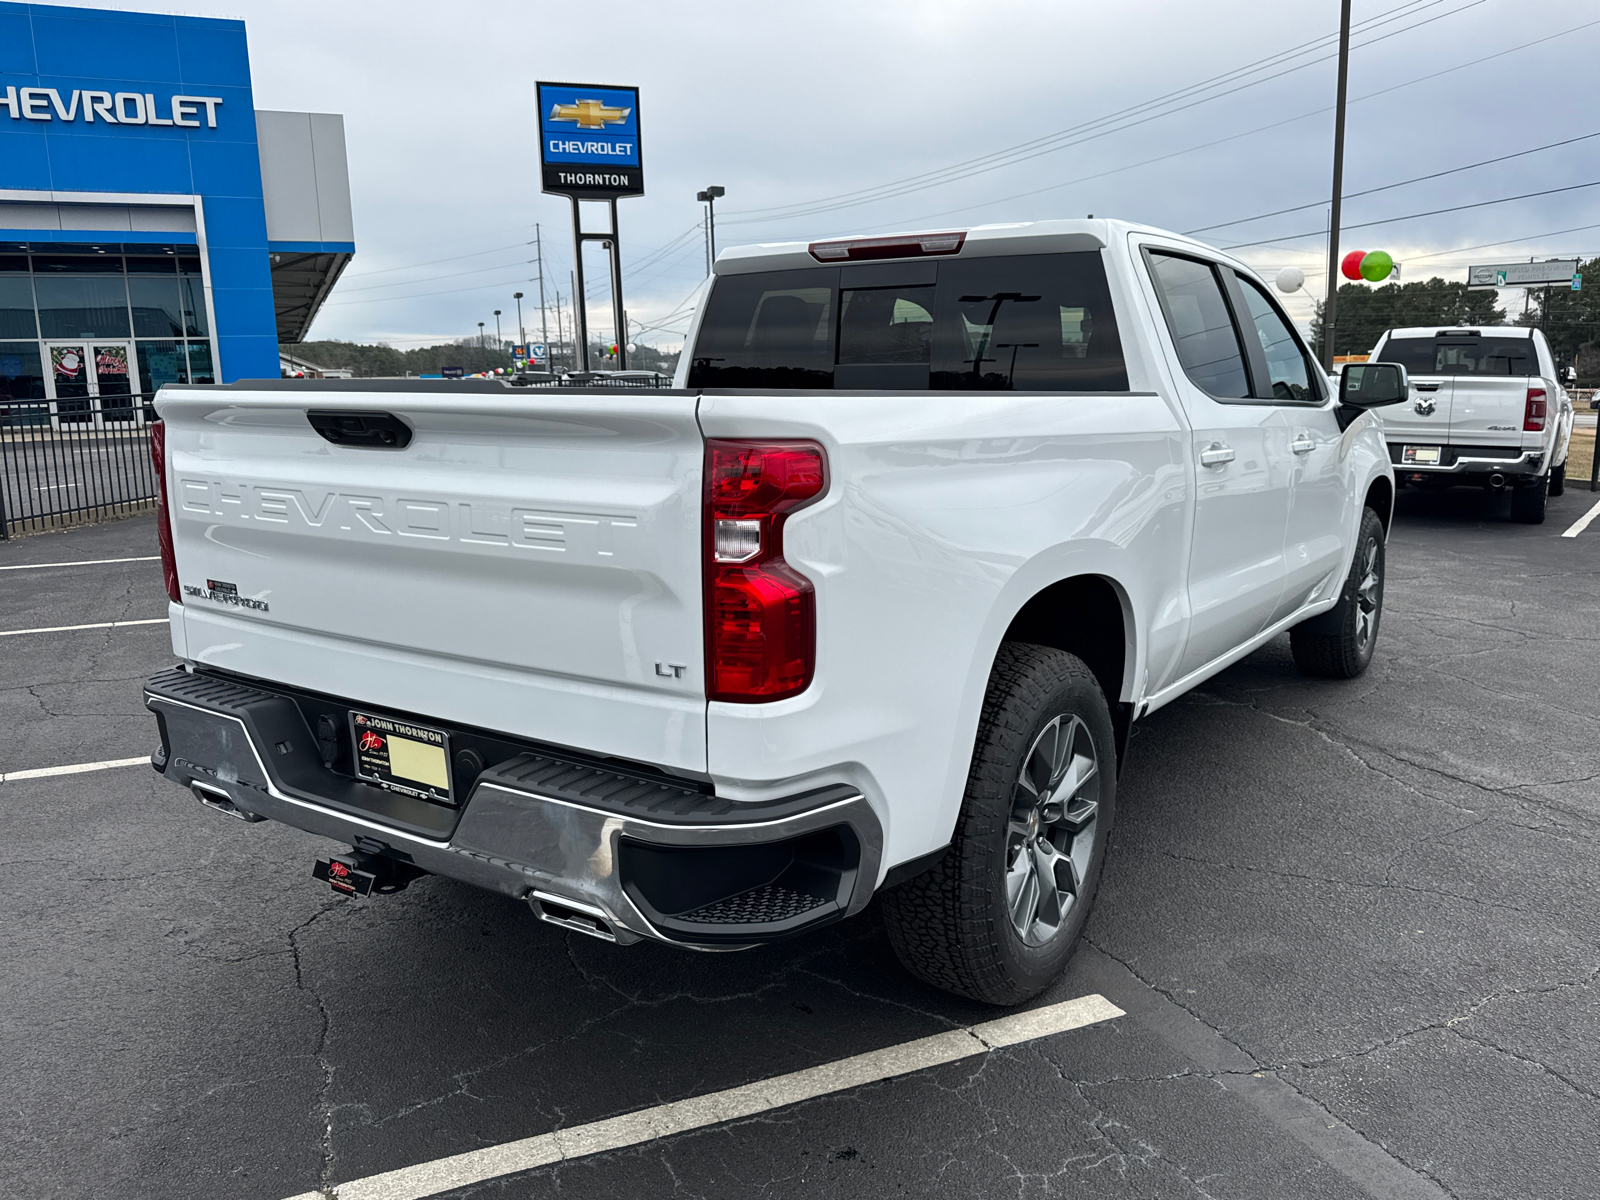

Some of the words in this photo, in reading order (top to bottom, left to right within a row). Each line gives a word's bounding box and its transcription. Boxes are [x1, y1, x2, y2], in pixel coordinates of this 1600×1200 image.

[549, 140, 633, 155] CHEVROLET
[559, 172, 629, 186] THORNTON
[180, 479, 638, 556] CHEVROLET
[655, 661, 687, 678] LT
[371, 718, 394, 731] JOHN
[394, 724, 442, 743] THORNTON
[390, 785, 418, 797] CHEVROLET
